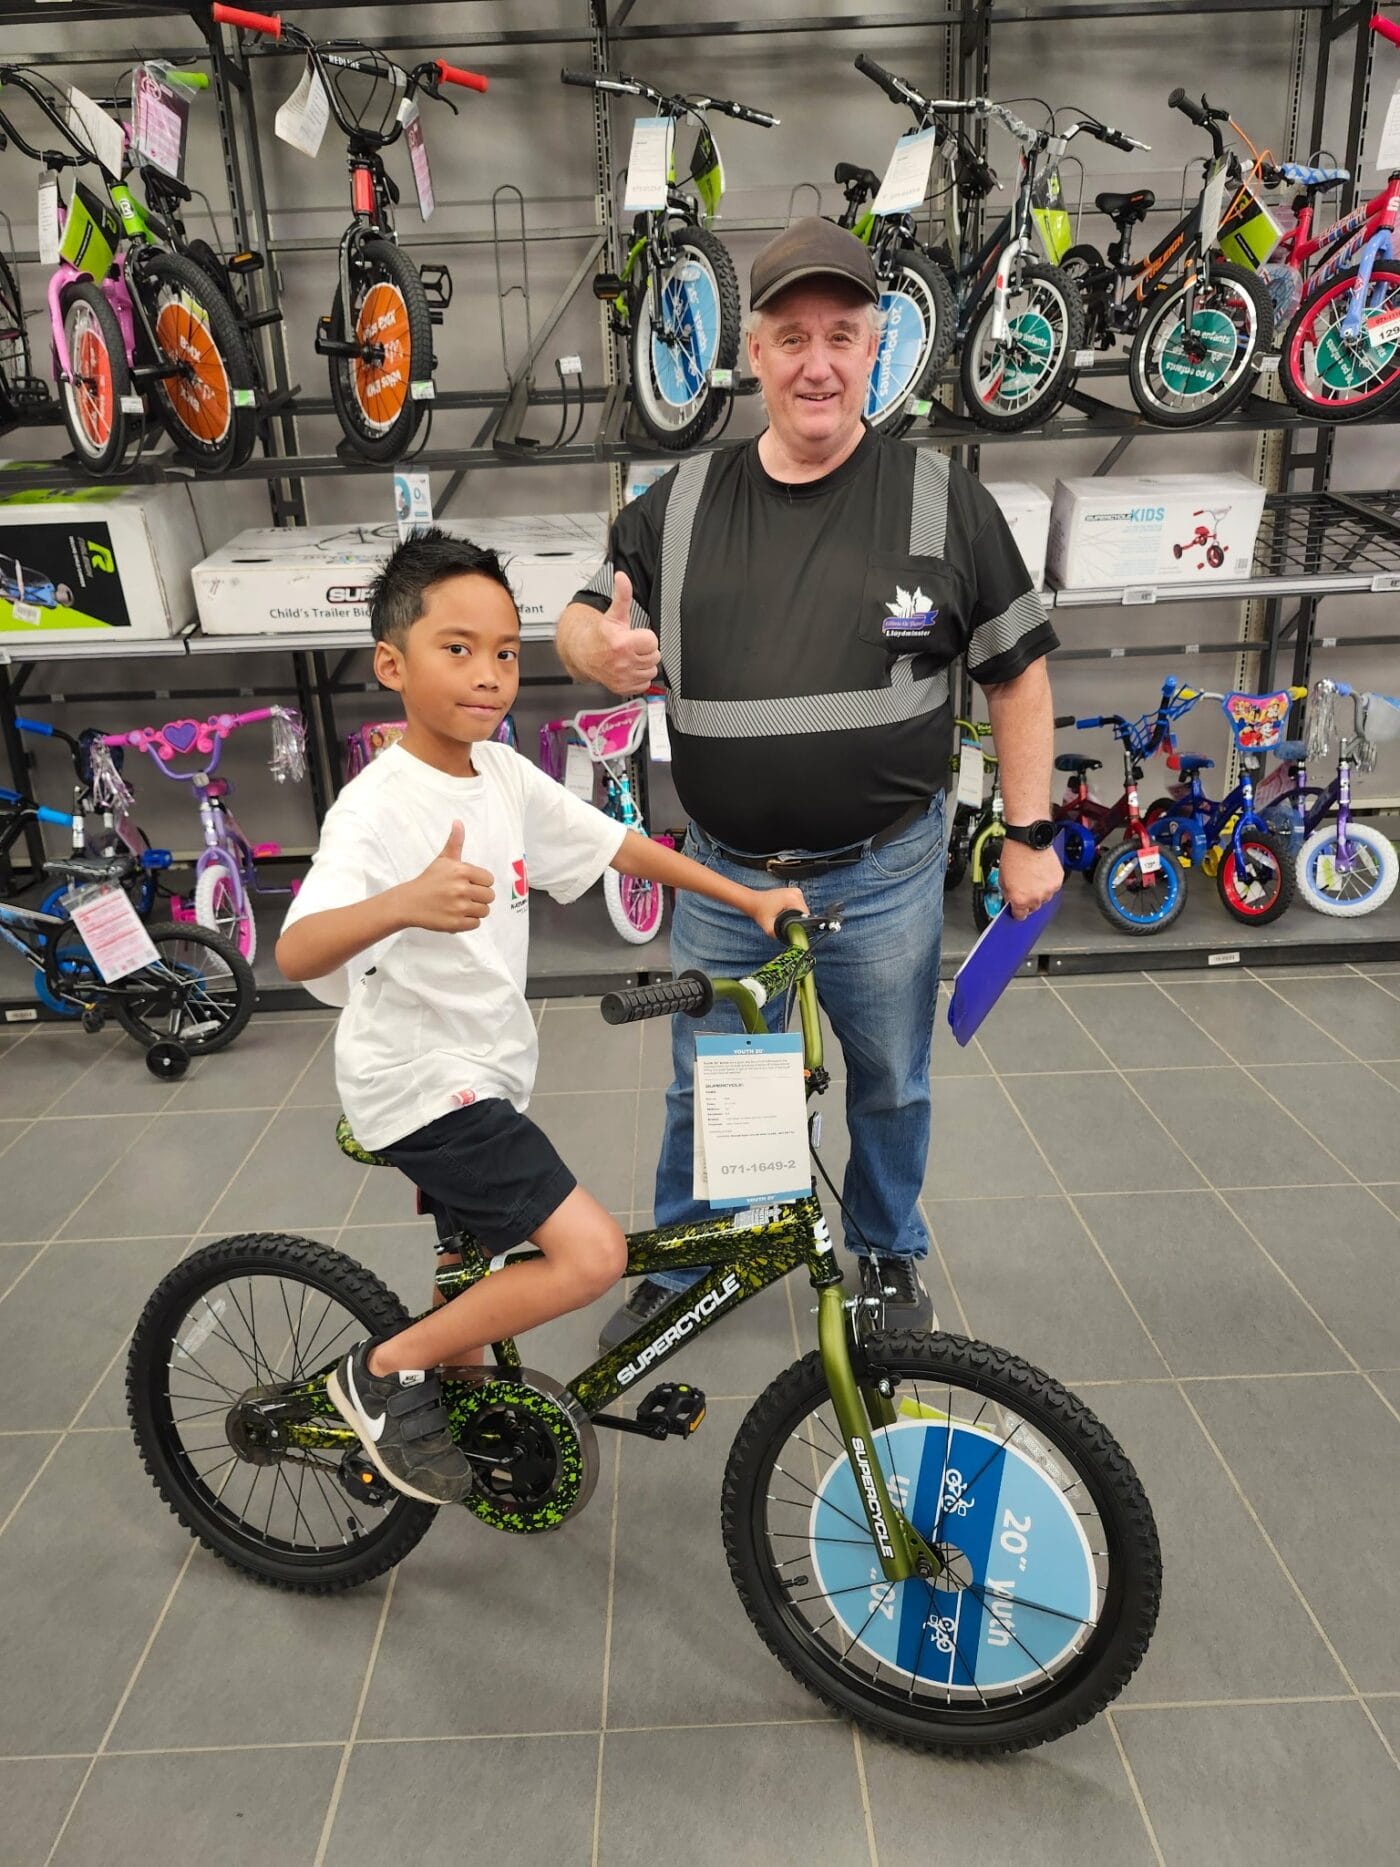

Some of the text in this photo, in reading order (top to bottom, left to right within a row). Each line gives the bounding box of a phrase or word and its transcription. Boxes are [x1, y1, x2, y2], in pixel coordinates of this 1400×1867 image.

[1201, 328, 1231, 345] enfants
[1130, 507, 1165, 523] KIDS
[269, 608, 309, 619] Child's
[312, 607, 350, 618] Trailer
[886, 630, 931, 638] Lloydminster
[721, 1160, 797, 1175] 071-1649-2
[616, 1272, 740, 1385] SUPERCYCLE
[851, 1436, 894, 1559] SUPERCYCLE
[1000, 1508, 1031, 1572] 20"
